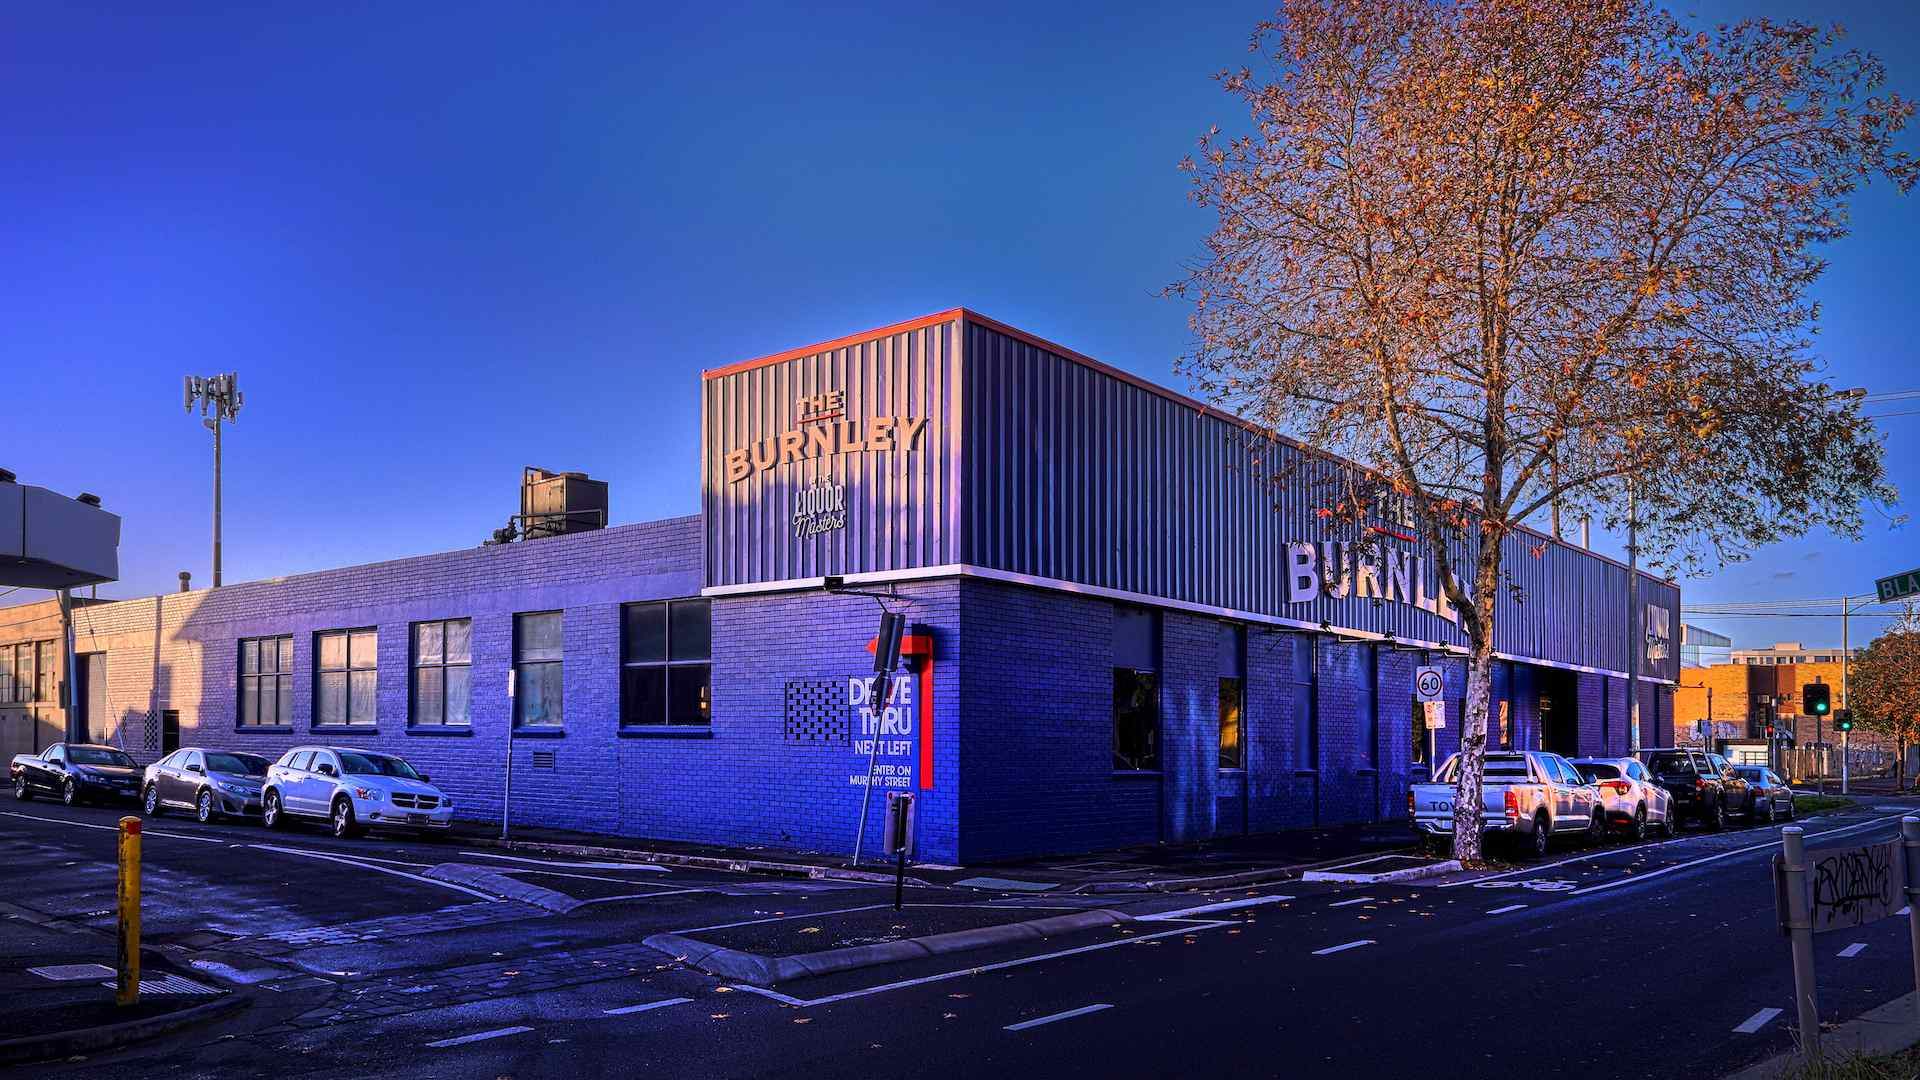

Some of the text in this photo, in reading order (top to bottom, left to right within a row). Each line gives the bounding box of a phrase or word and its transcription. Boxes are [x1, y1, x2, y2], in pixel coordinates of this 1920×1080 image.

[796, 391, 845, 417] THE
[725, 416, 929, 483] BURNLEY
[795, 485, 844, 517] LIQUOR
[793, 514, 844, 539] Masters
[849, 677, 912, 705] DVE
[1421, 678, 1438, 690] 60
[859, 707, 912, 735] THRU
[887, 741, 912, 755] LEFT
[850, 775, 910, 787] MURHY STREET
[897, 765, 911, 776] ON
